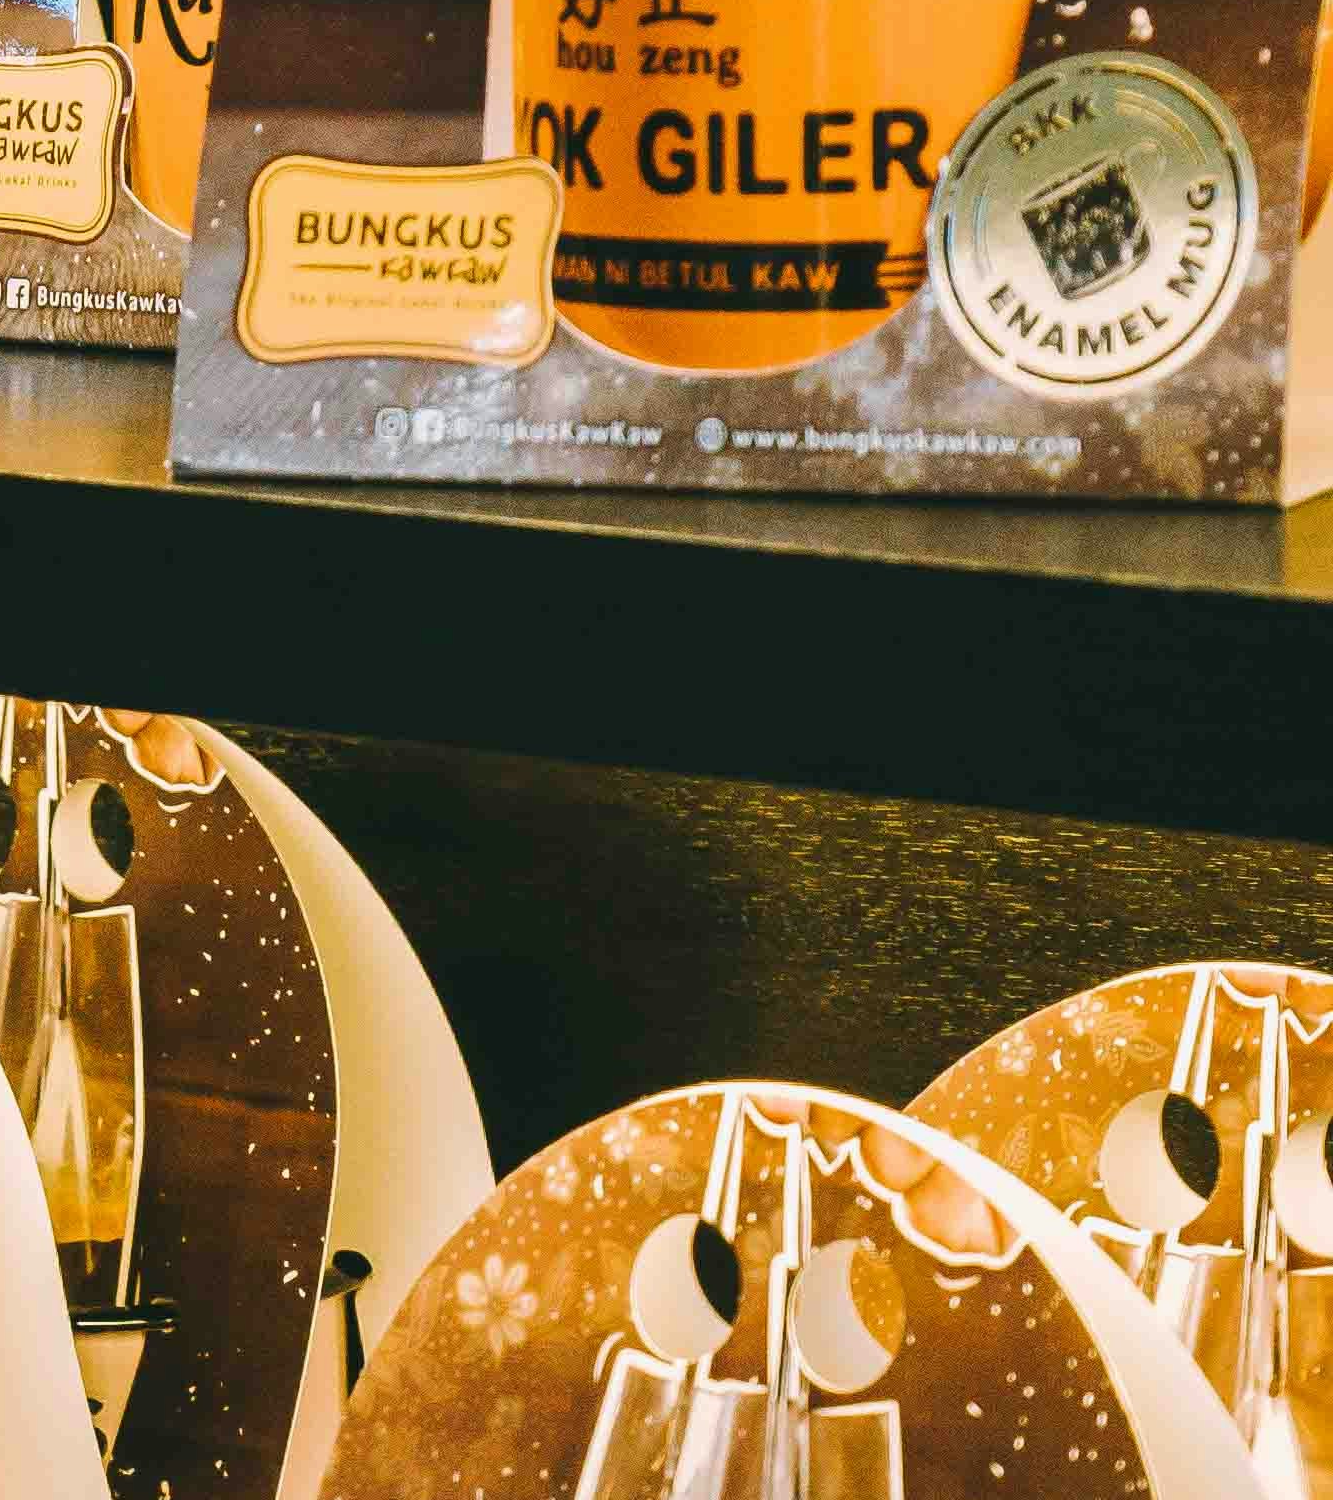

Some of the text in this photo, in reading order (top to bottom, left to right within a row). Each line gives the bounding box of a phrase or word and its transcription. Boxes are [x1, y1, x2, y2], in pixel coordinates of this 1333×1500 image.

[557, 26, 742, 88] hou zeng
[636, 108, 935, 195] GILER
[1010, 95, 1100, 157] BKK
[296, 210, 517, 250] BUNGKUS
[750, 260, 840, 293] KAW
[986, 175, 1221, 357] ENAMEL MUG
